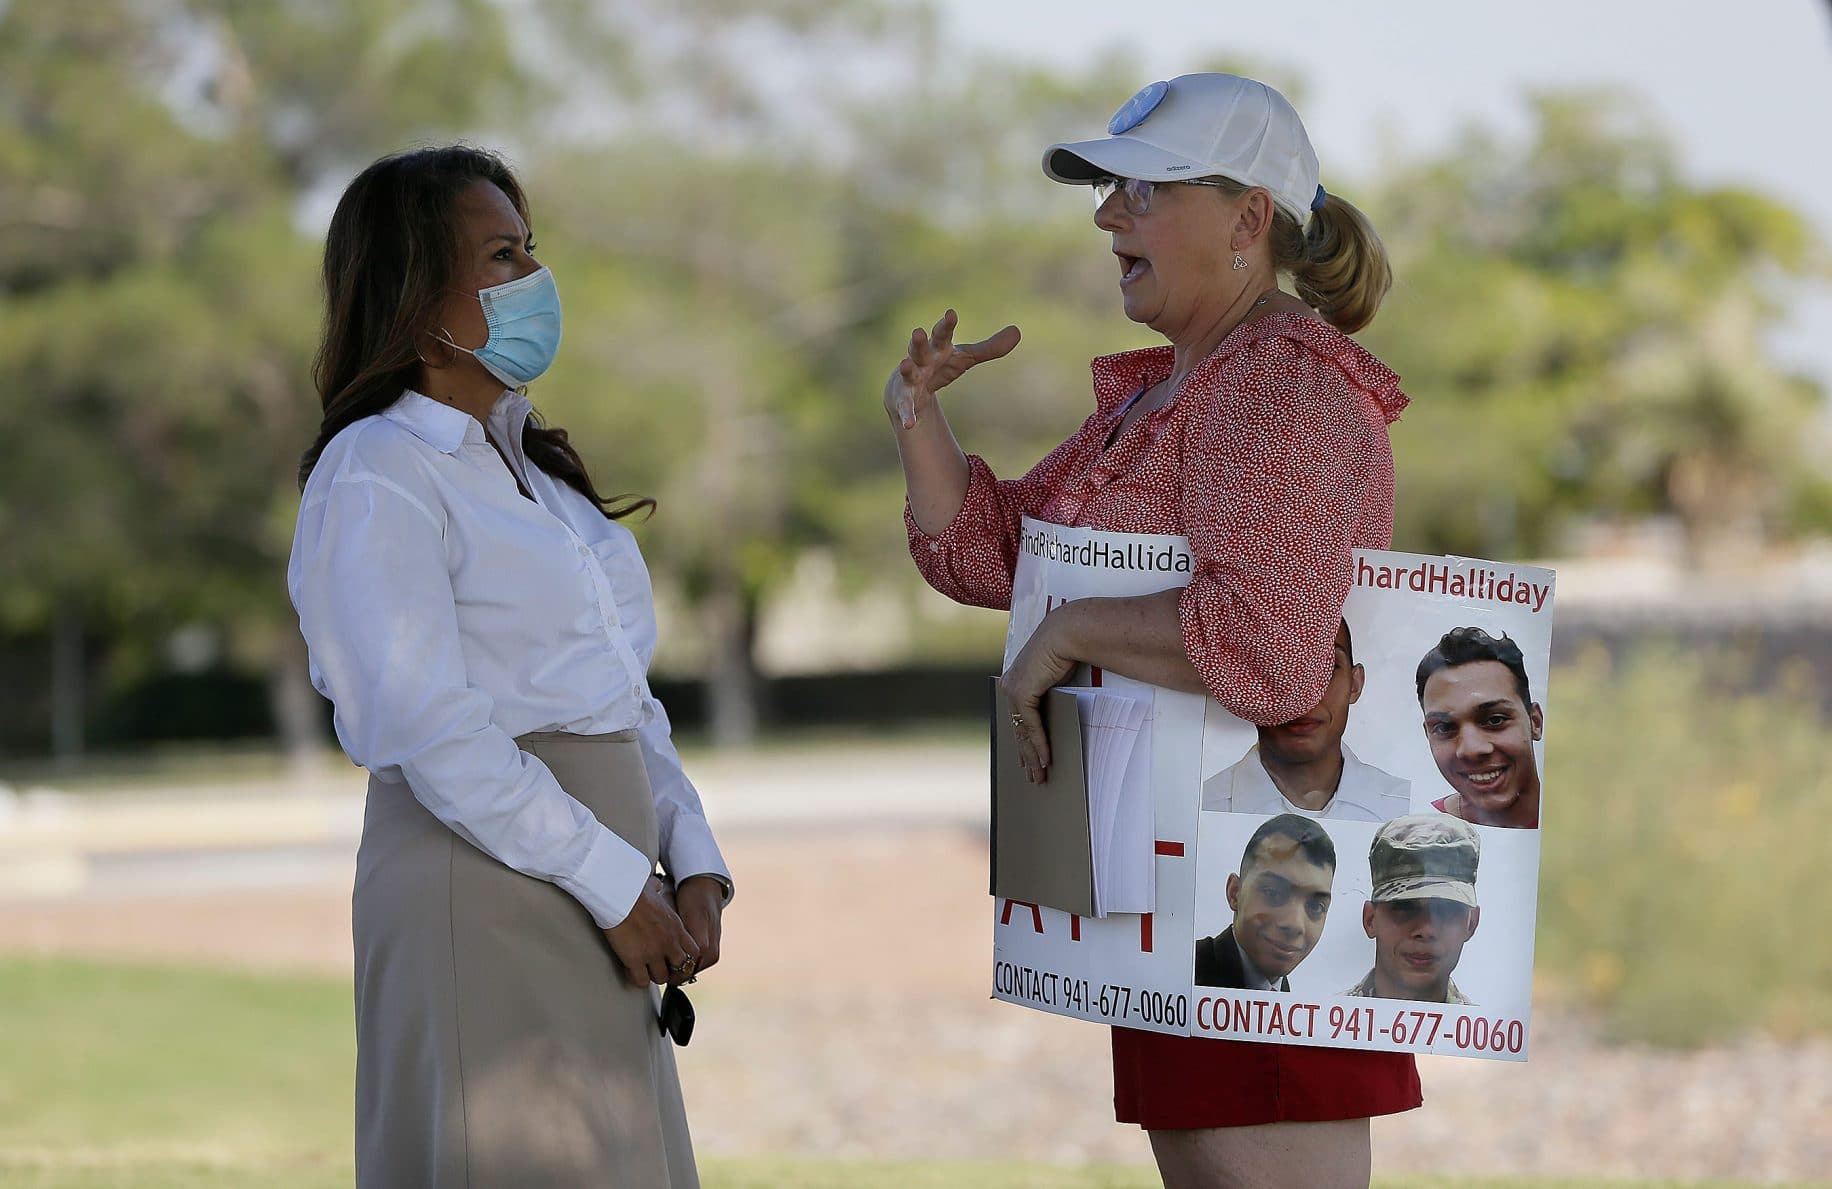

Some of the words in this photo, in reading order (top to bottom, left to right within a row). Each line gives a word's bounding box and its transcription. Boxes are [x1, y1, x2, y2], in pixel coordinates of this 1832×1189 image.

[1352, 556, 1550, 613] hardHalliday
[995, 961, 1059, 1006] CONTACT
[1063, 976, 1187, 1028] 941-677-0060
[1197, 997, 1320, 1038] CONTACT
[1329, 1005, 1524, 1054] 941-677-0060
